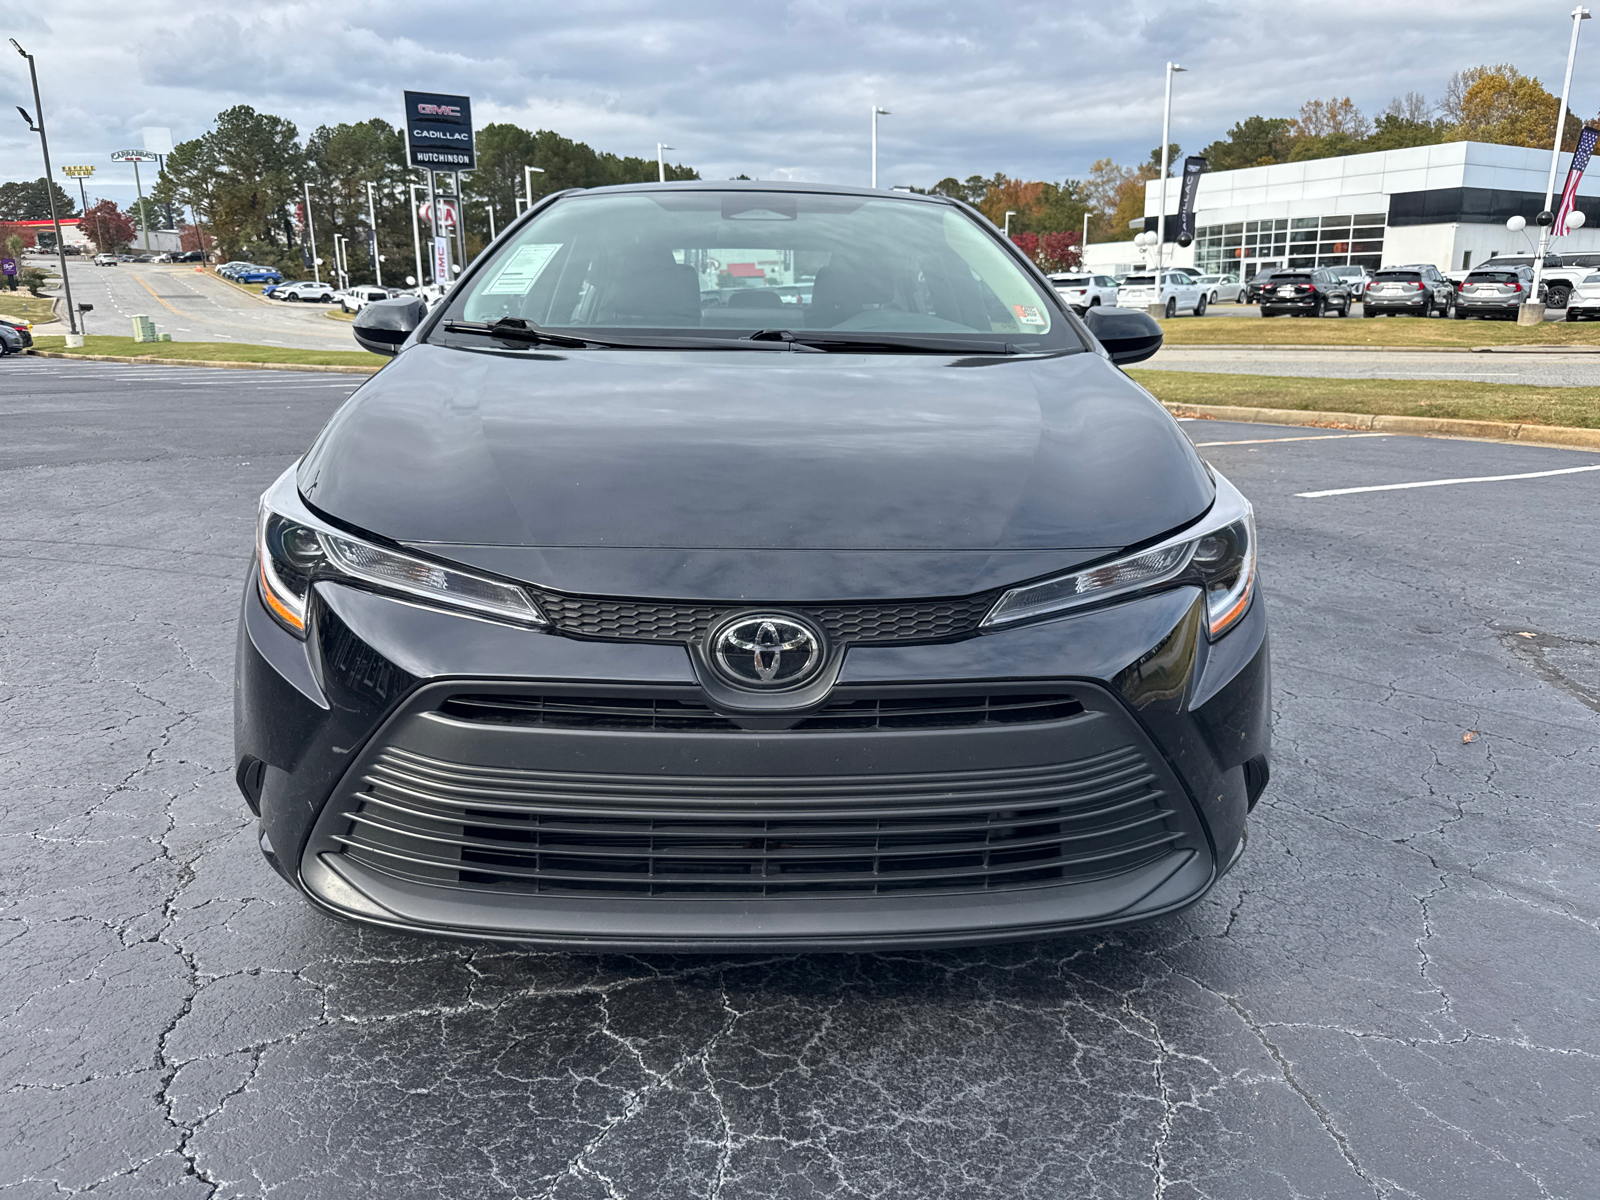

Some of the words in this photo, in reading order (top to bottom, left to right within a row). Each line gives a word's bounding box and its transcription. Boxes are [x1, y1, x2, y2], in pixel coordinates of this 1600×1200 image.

[418, 103, 461, 117] GMC
[413, 129, 469, 141] CADILLAC
[417, 152, 469, 164] HUTCHINSON
[1181, 175, 1194, 234] ADILLAC
[437, 246, 446, 278] GMC
